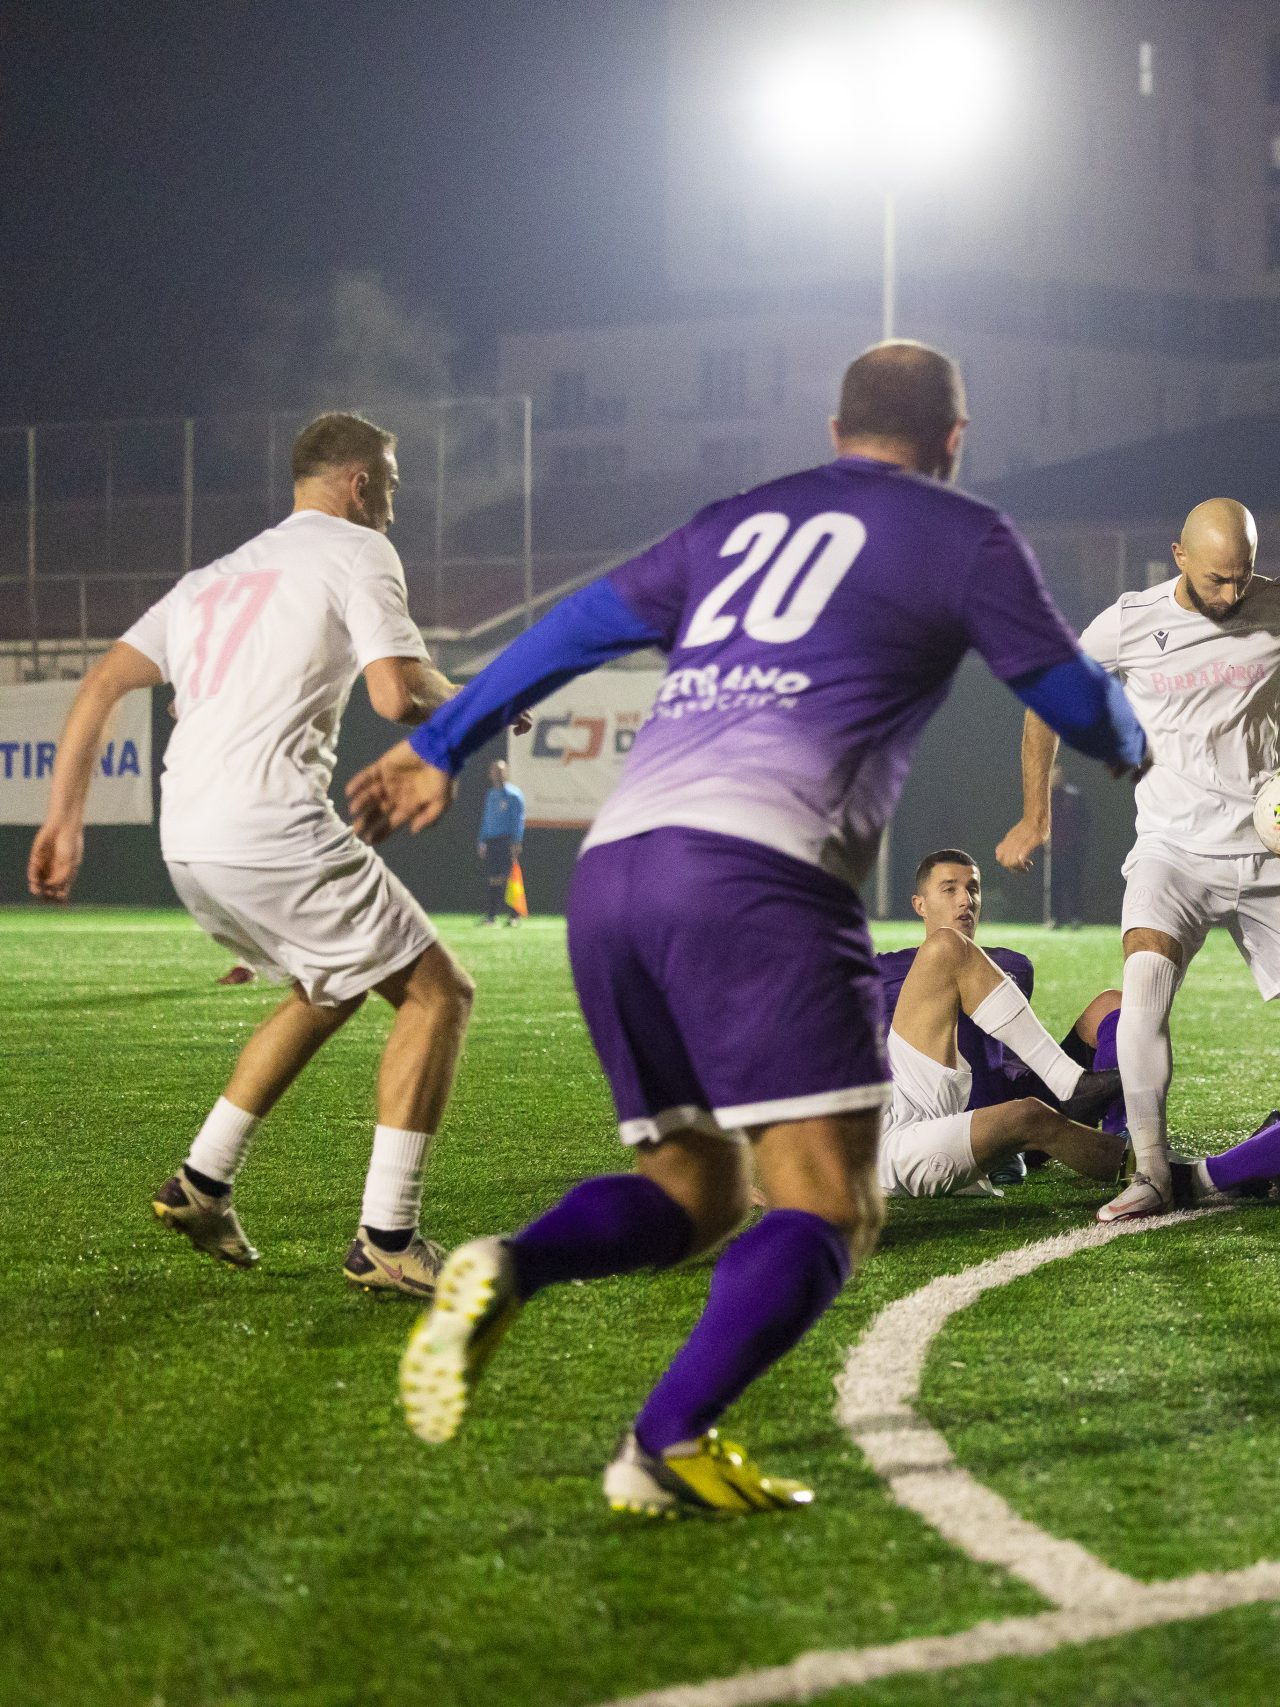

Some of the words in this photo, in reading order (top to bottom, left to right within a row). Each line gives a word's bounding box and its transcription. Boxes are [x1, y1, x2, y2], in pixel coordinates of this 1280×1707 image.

[191, 569, 282, 700] 17
[680, 511, 867, 648] 20
[0, 740, 140, 779] TIRNA
